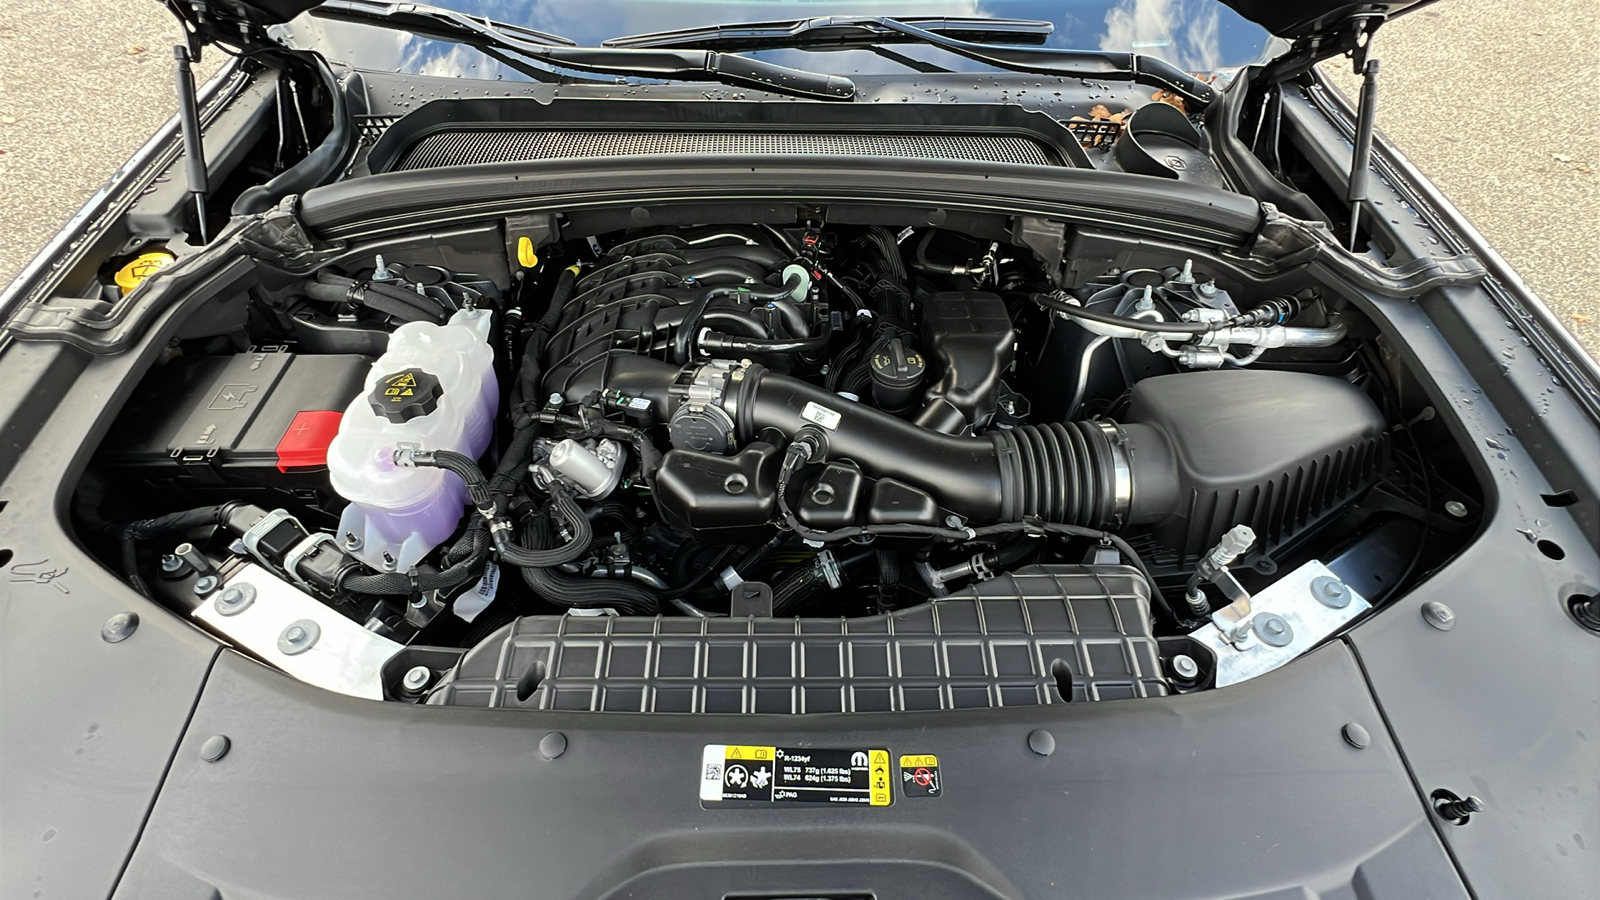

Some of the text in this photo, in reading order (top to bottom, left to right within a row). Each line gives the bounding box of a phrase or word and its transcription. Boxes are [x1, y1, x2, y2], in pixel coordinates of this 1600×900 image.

[784, 755, 811, 763] R-1234yf
[805, 766, 820, 775] 737g
[839, 767, 851, 776] lbs)
[804, 774, 820, 783] 624g
[839, 775, 851, 784] lbs)
